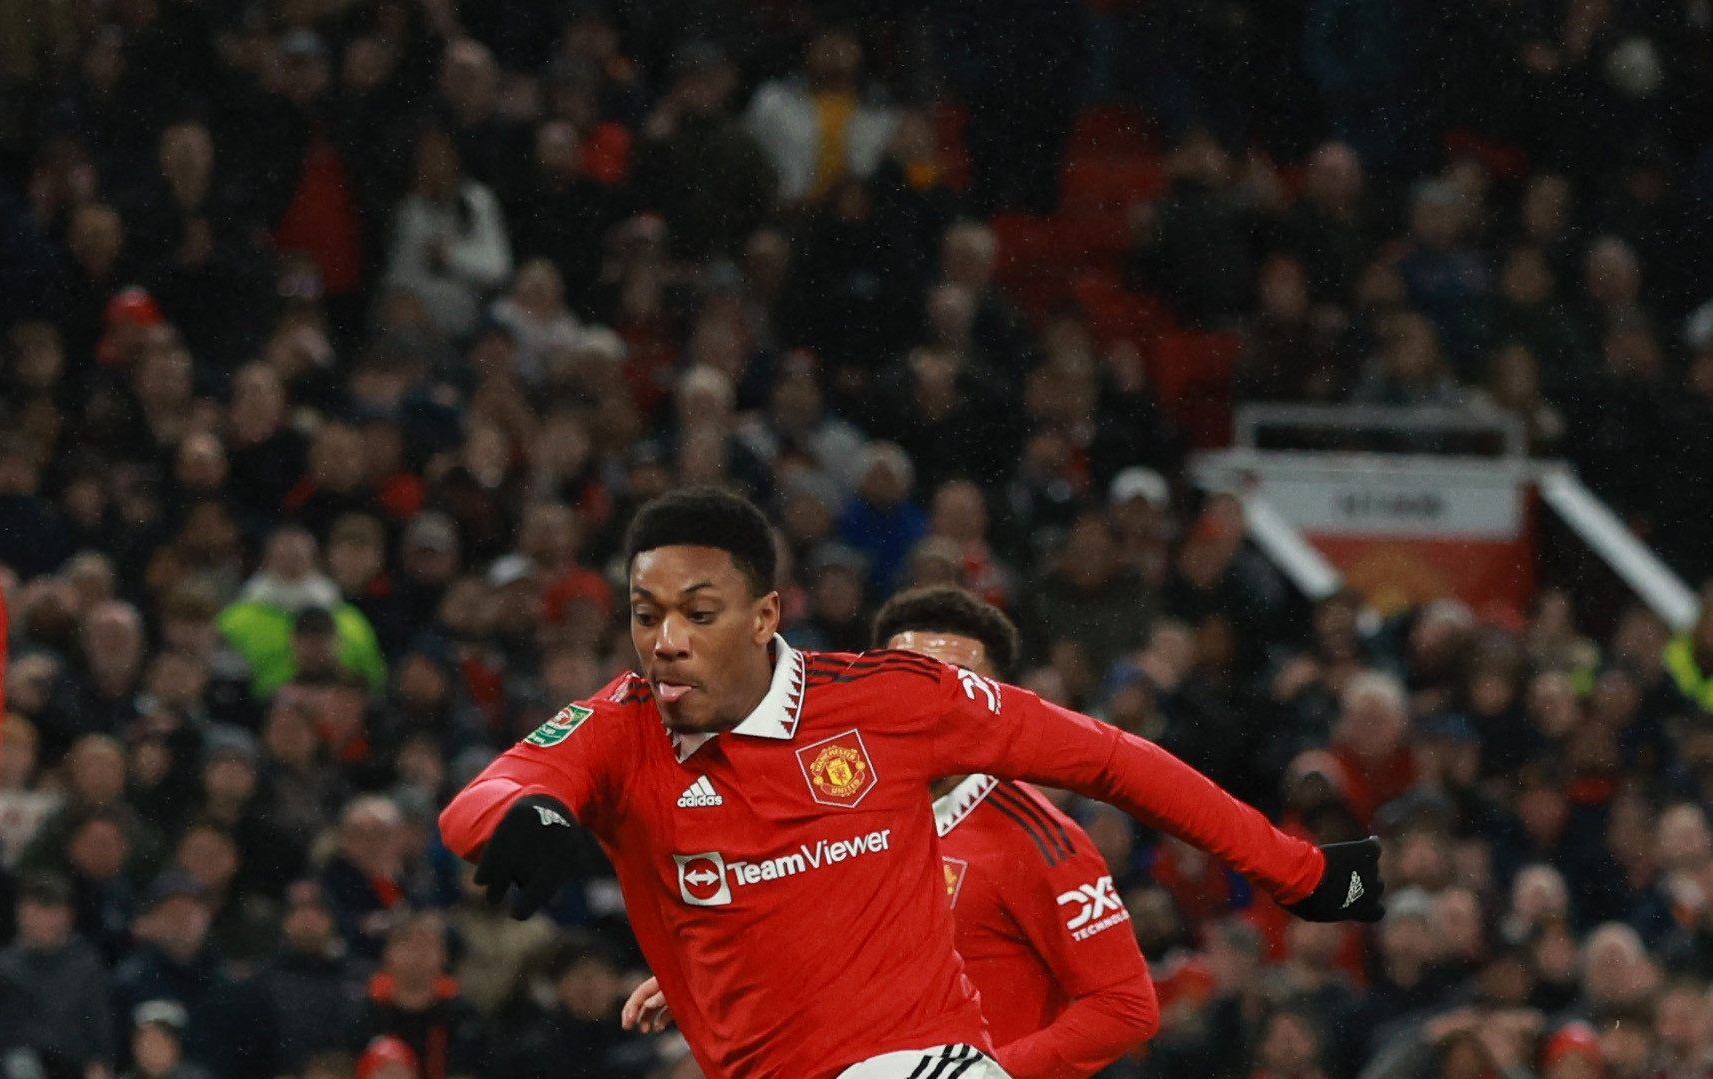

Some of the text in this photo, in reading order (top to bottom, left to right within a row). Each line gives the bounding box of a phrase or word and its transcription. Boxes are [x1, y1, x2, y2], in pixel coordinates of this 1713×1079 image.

[677, 795, 723, 807] adidas
[727, 829, 891, 885] TeamViewer
[1056, 875, 1124, 930] DX
